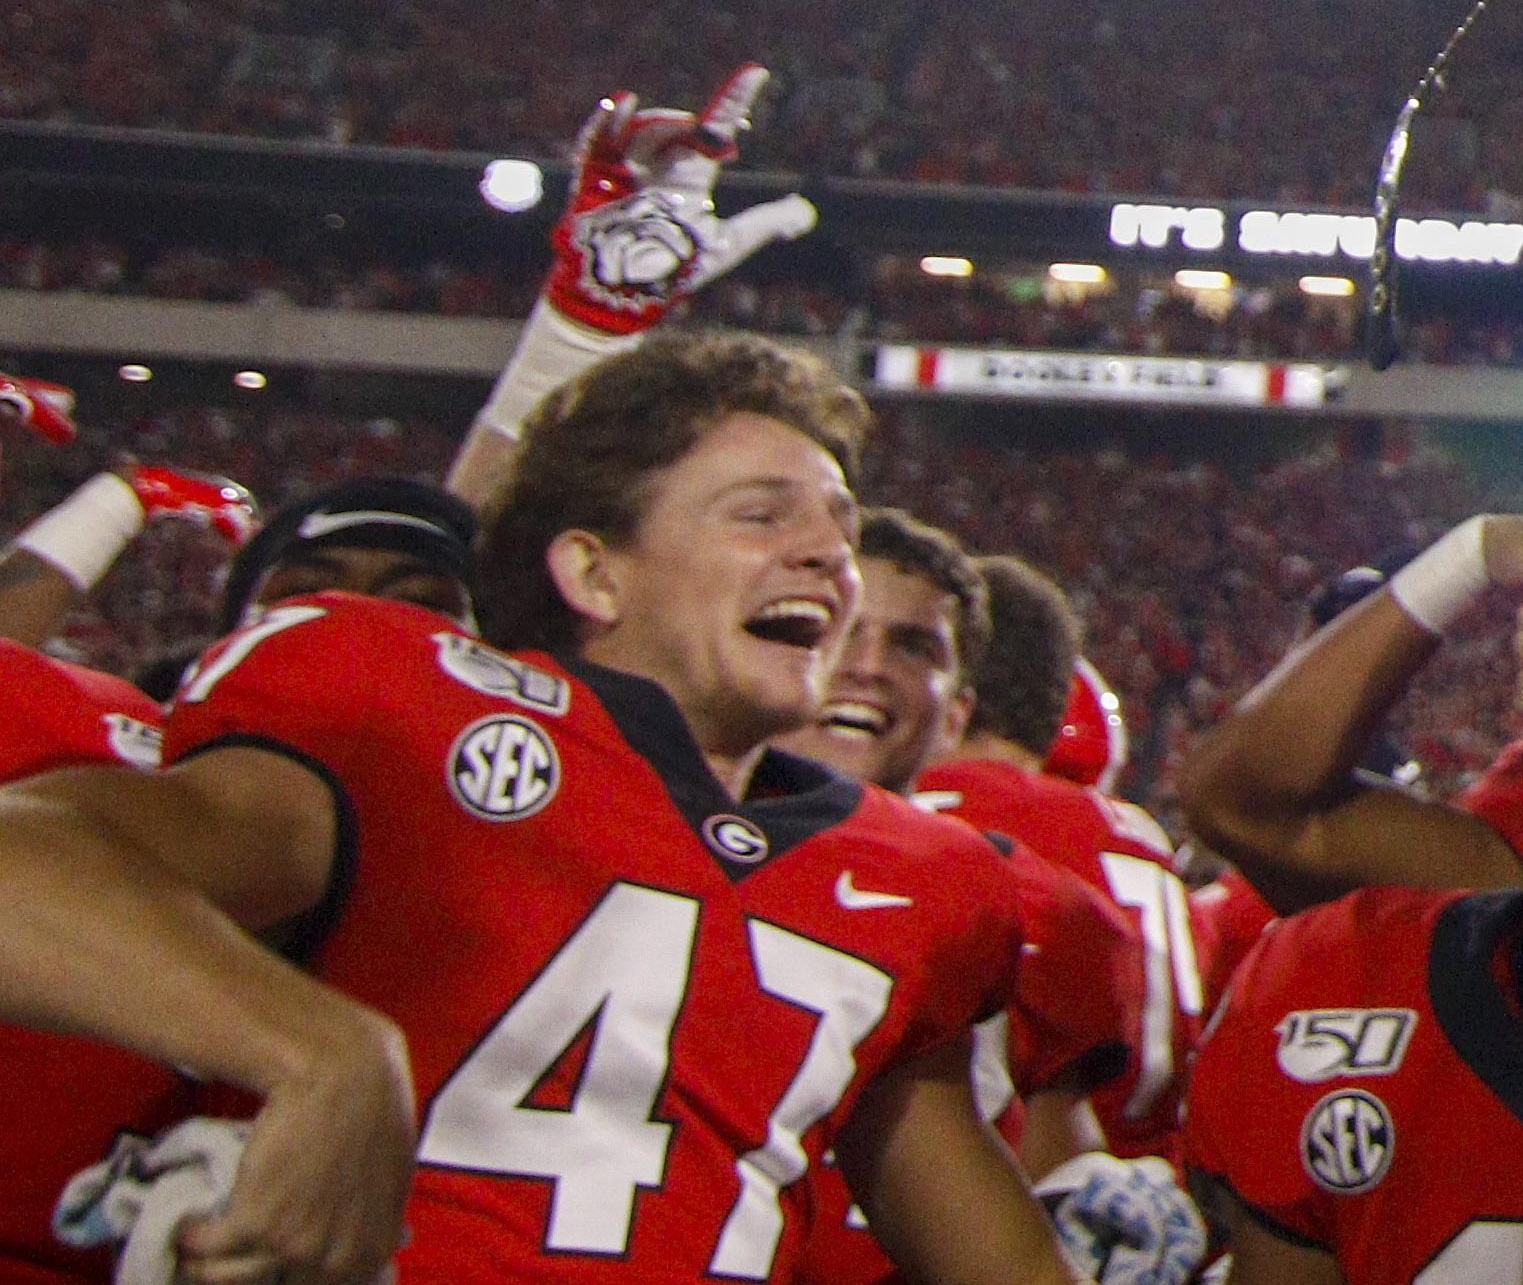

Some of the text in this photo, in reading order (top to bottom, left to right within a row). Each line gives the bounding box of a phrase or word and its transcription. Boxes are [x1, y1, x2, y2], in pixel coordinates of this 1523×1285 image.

[457, 721, 551, 812] SEC
[416, 878, 895, 1281] 47
[1282, 1012, 1412, 1073] 150
[1309, 1097, 1387, 1187] SEC
